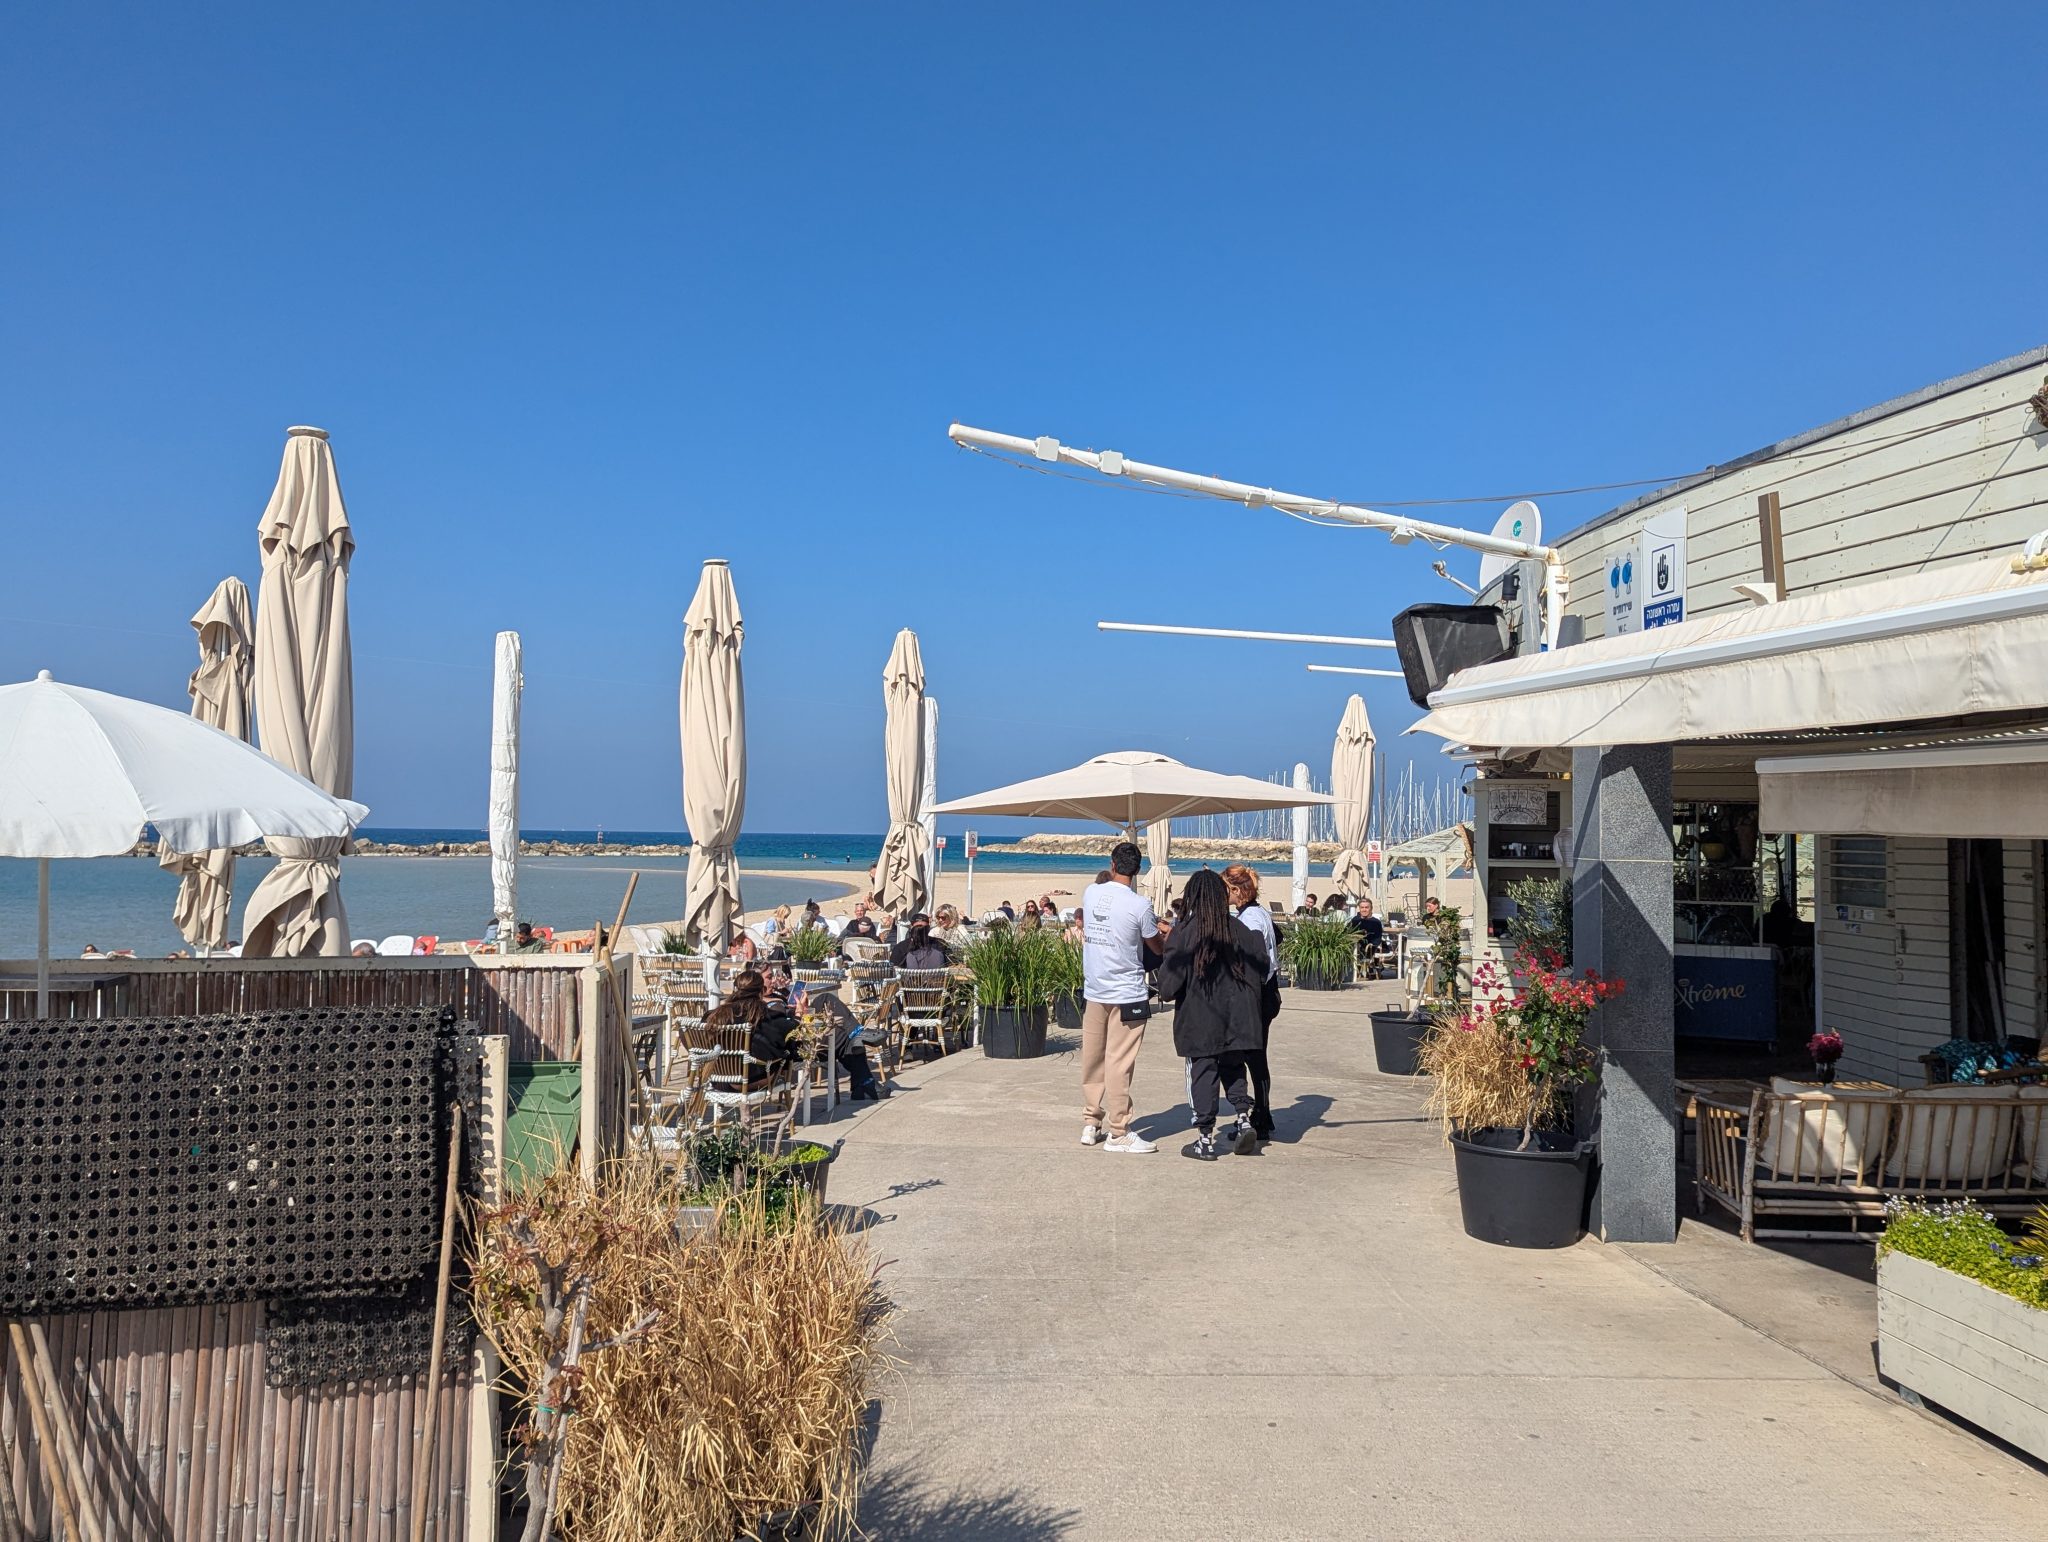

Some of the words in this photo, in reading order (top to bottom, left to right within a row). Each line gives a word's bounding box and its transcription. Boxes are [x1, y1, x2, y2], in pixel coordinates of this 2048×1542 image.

[1613, 601, 1632, 616] שירותים
[1646, 606, 1665, 620] ראשונה
[1666, 602, 1680, 615] עזרה
